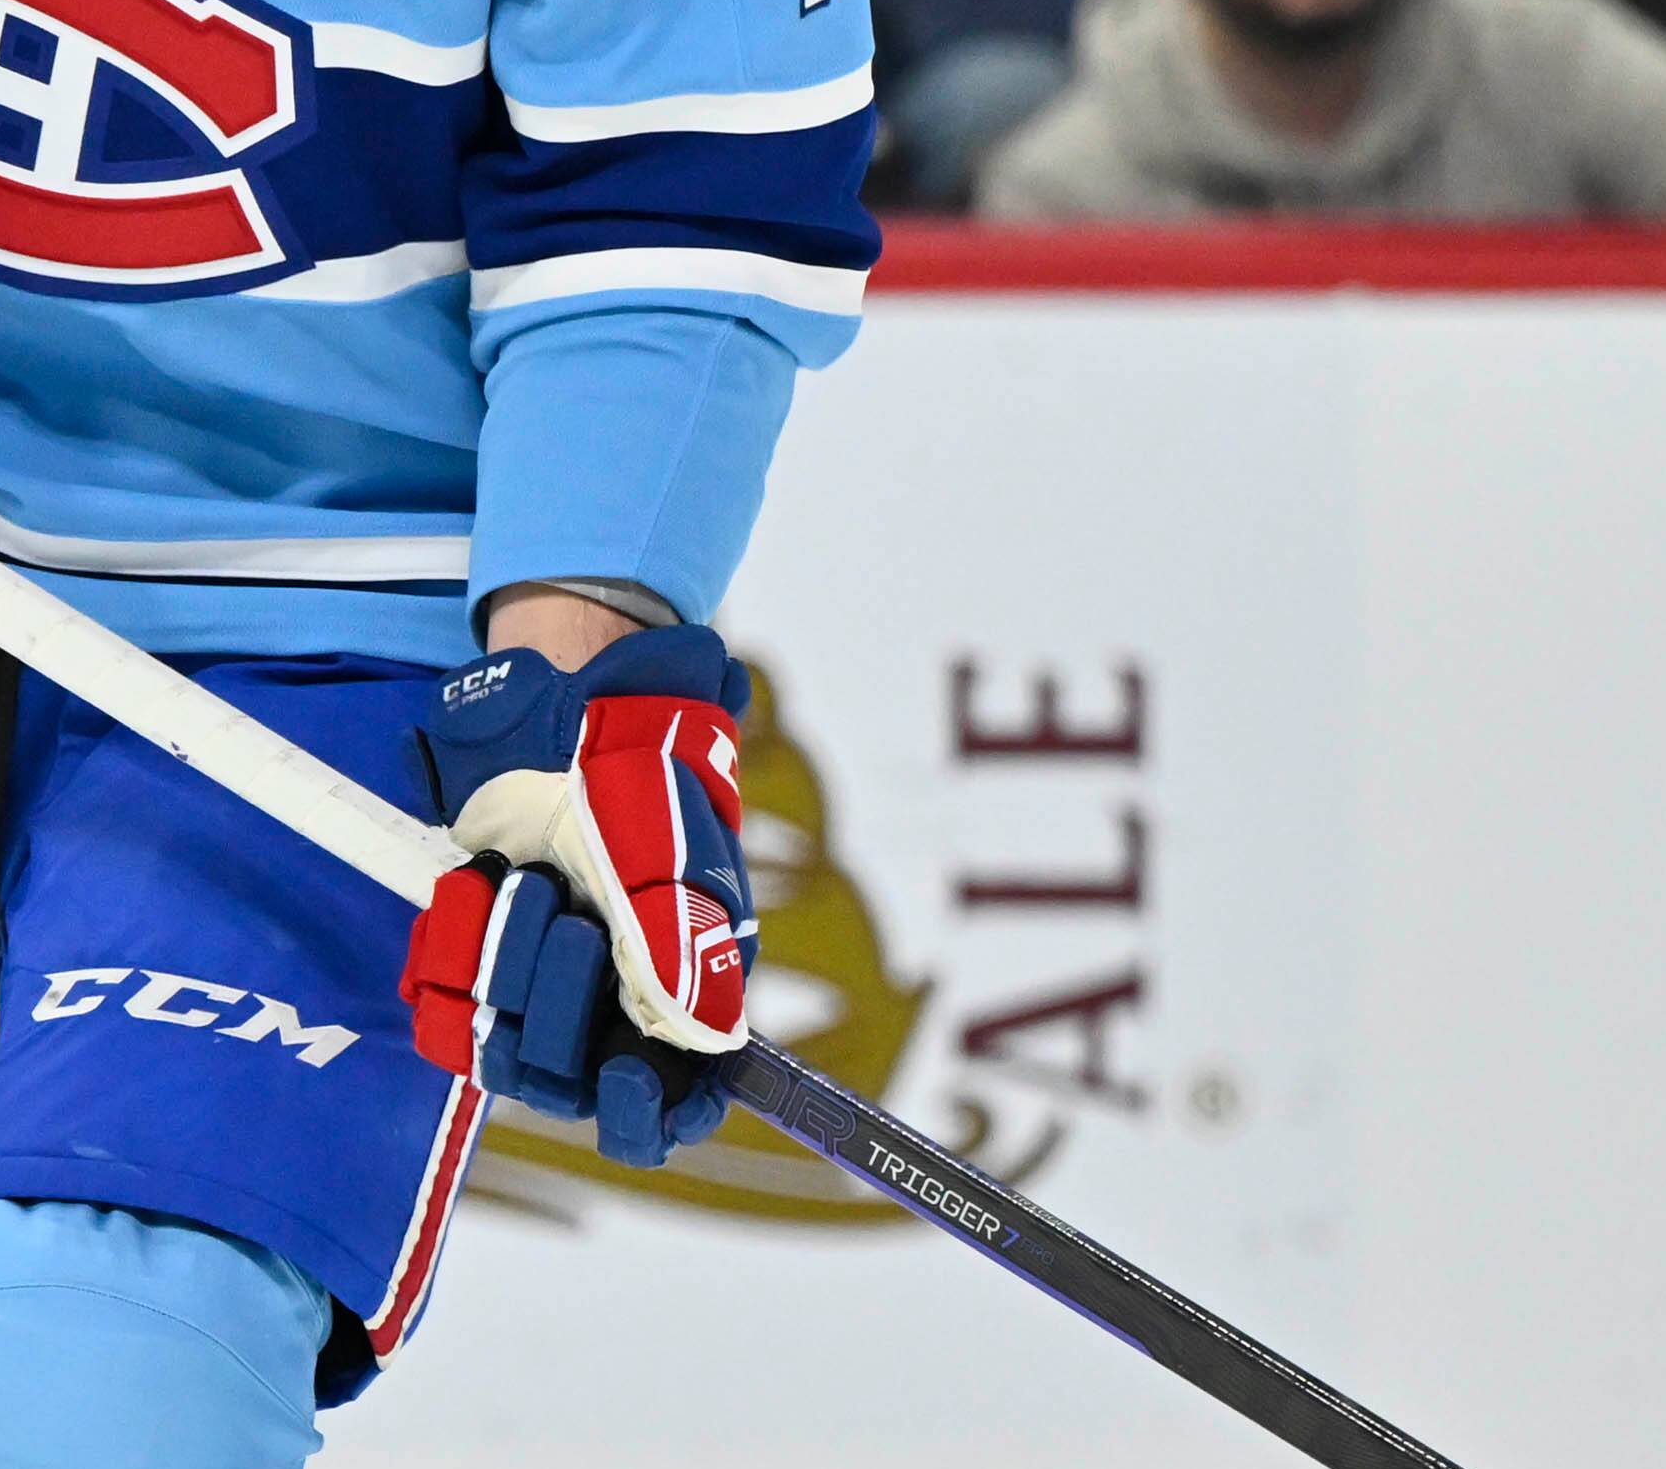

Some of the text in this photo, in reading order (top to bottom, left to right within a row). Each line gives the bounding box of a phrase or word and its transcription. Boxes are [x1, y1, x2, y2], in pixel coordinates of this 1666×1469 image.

[443, 660, 512, 703] CCM
[951, 653, 1149, 1109] ALE
[32, 967, 362, 1069] CCM
[867, 1140, 1001, 1240] TRIGGER
[1001, 1225, 1021, 1249] 7
